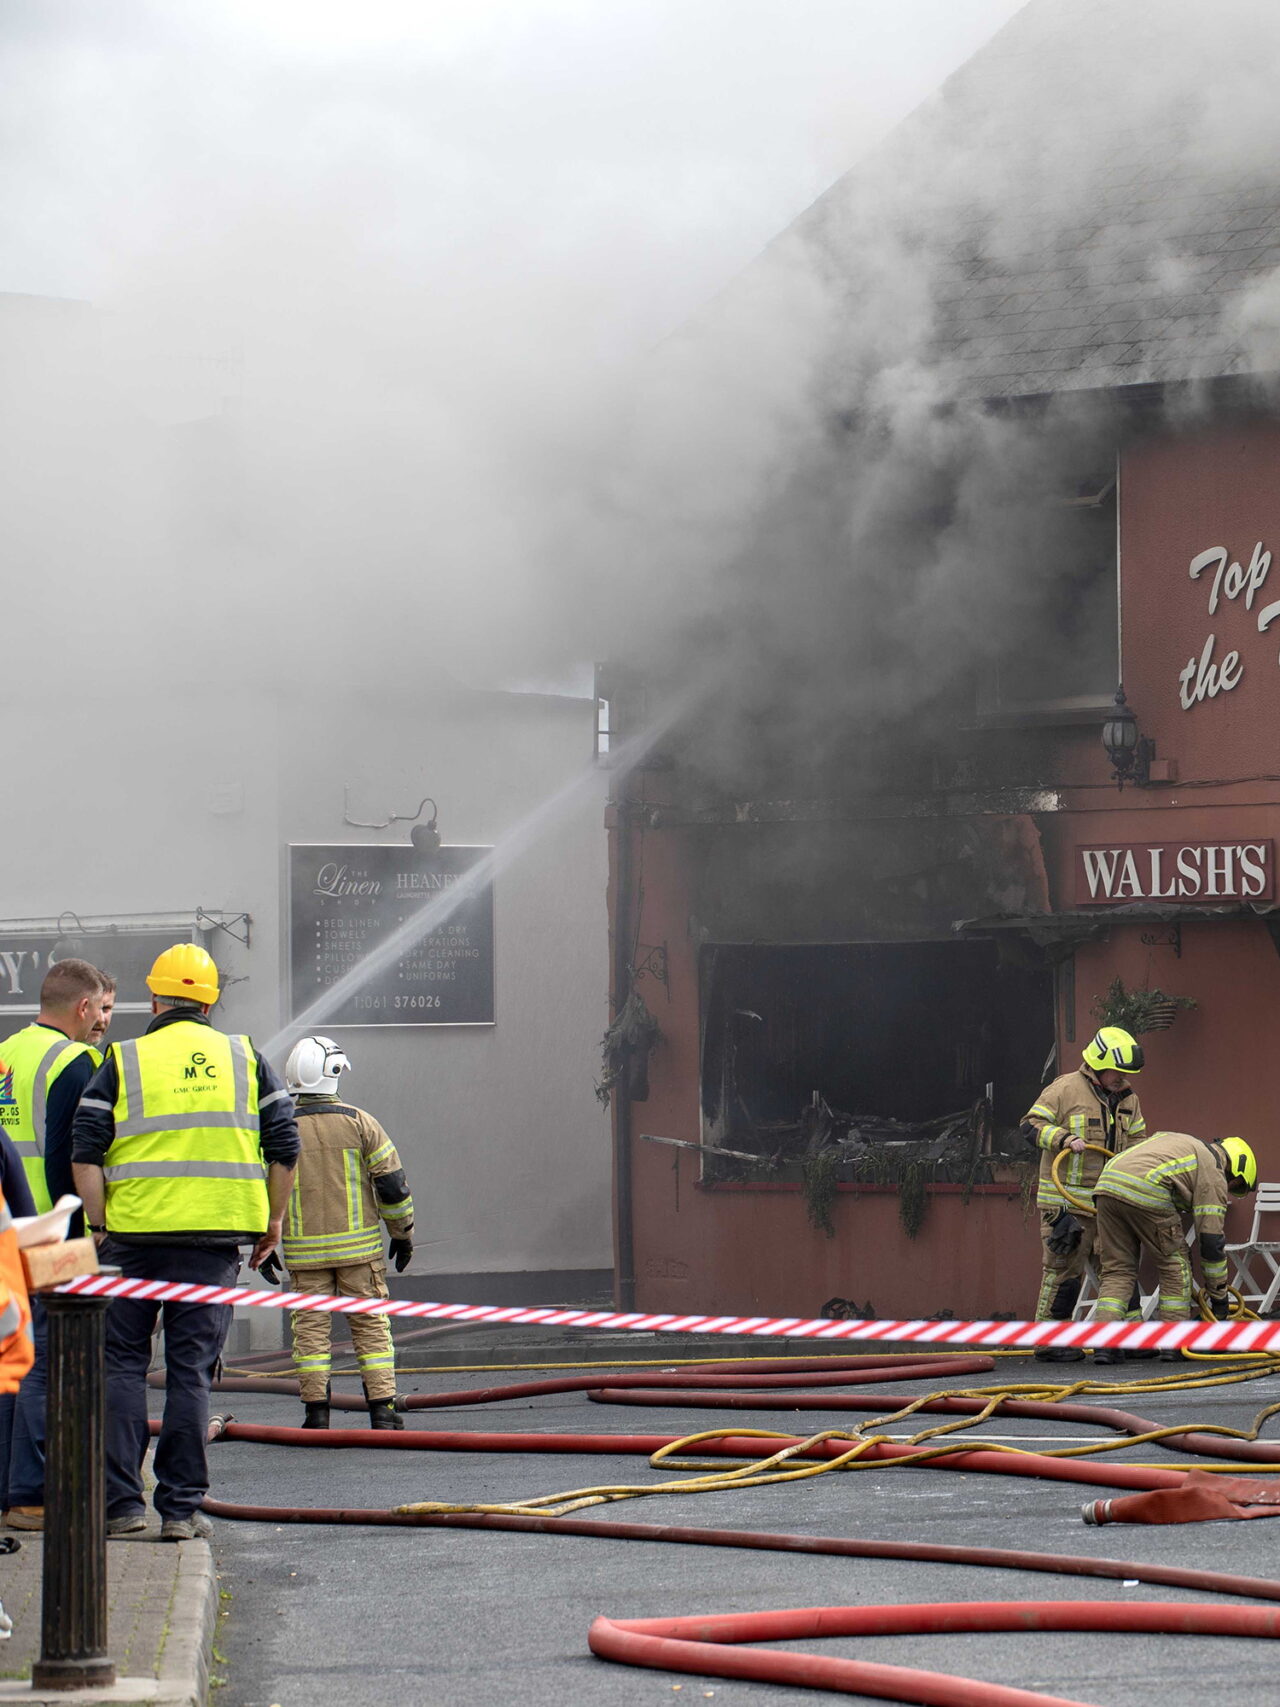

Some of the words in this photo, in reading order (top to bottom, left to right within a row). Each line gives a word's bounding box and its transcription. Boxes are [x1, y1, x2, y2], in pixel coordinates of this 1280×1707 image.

[1189, 541, 1272, 615] Top
[1179, 633, 1243, 710] the
[1082, 844, 1266, 898] WALSH'S
[312, 862, 383, 897] Linen
[324, 919, 344, 928] BED
[349, 919, 381, 928] LINEN
[324, 930, 366, 939] TOWELS
[324, 941, 361, 951] SHEETS
[429, 949, 480, 958] CLEANING
[405, 960, 433, 969] SAME
[436, 960, 457, 969] DAY
[405, 972, 457, 981] UNIFORMS
[394, 995, 441, 1009] 376026
[191, 1052, 207, 1065] G
[184, 1066, 197, 1079] M
[205, 1065, 216, 1078] C
